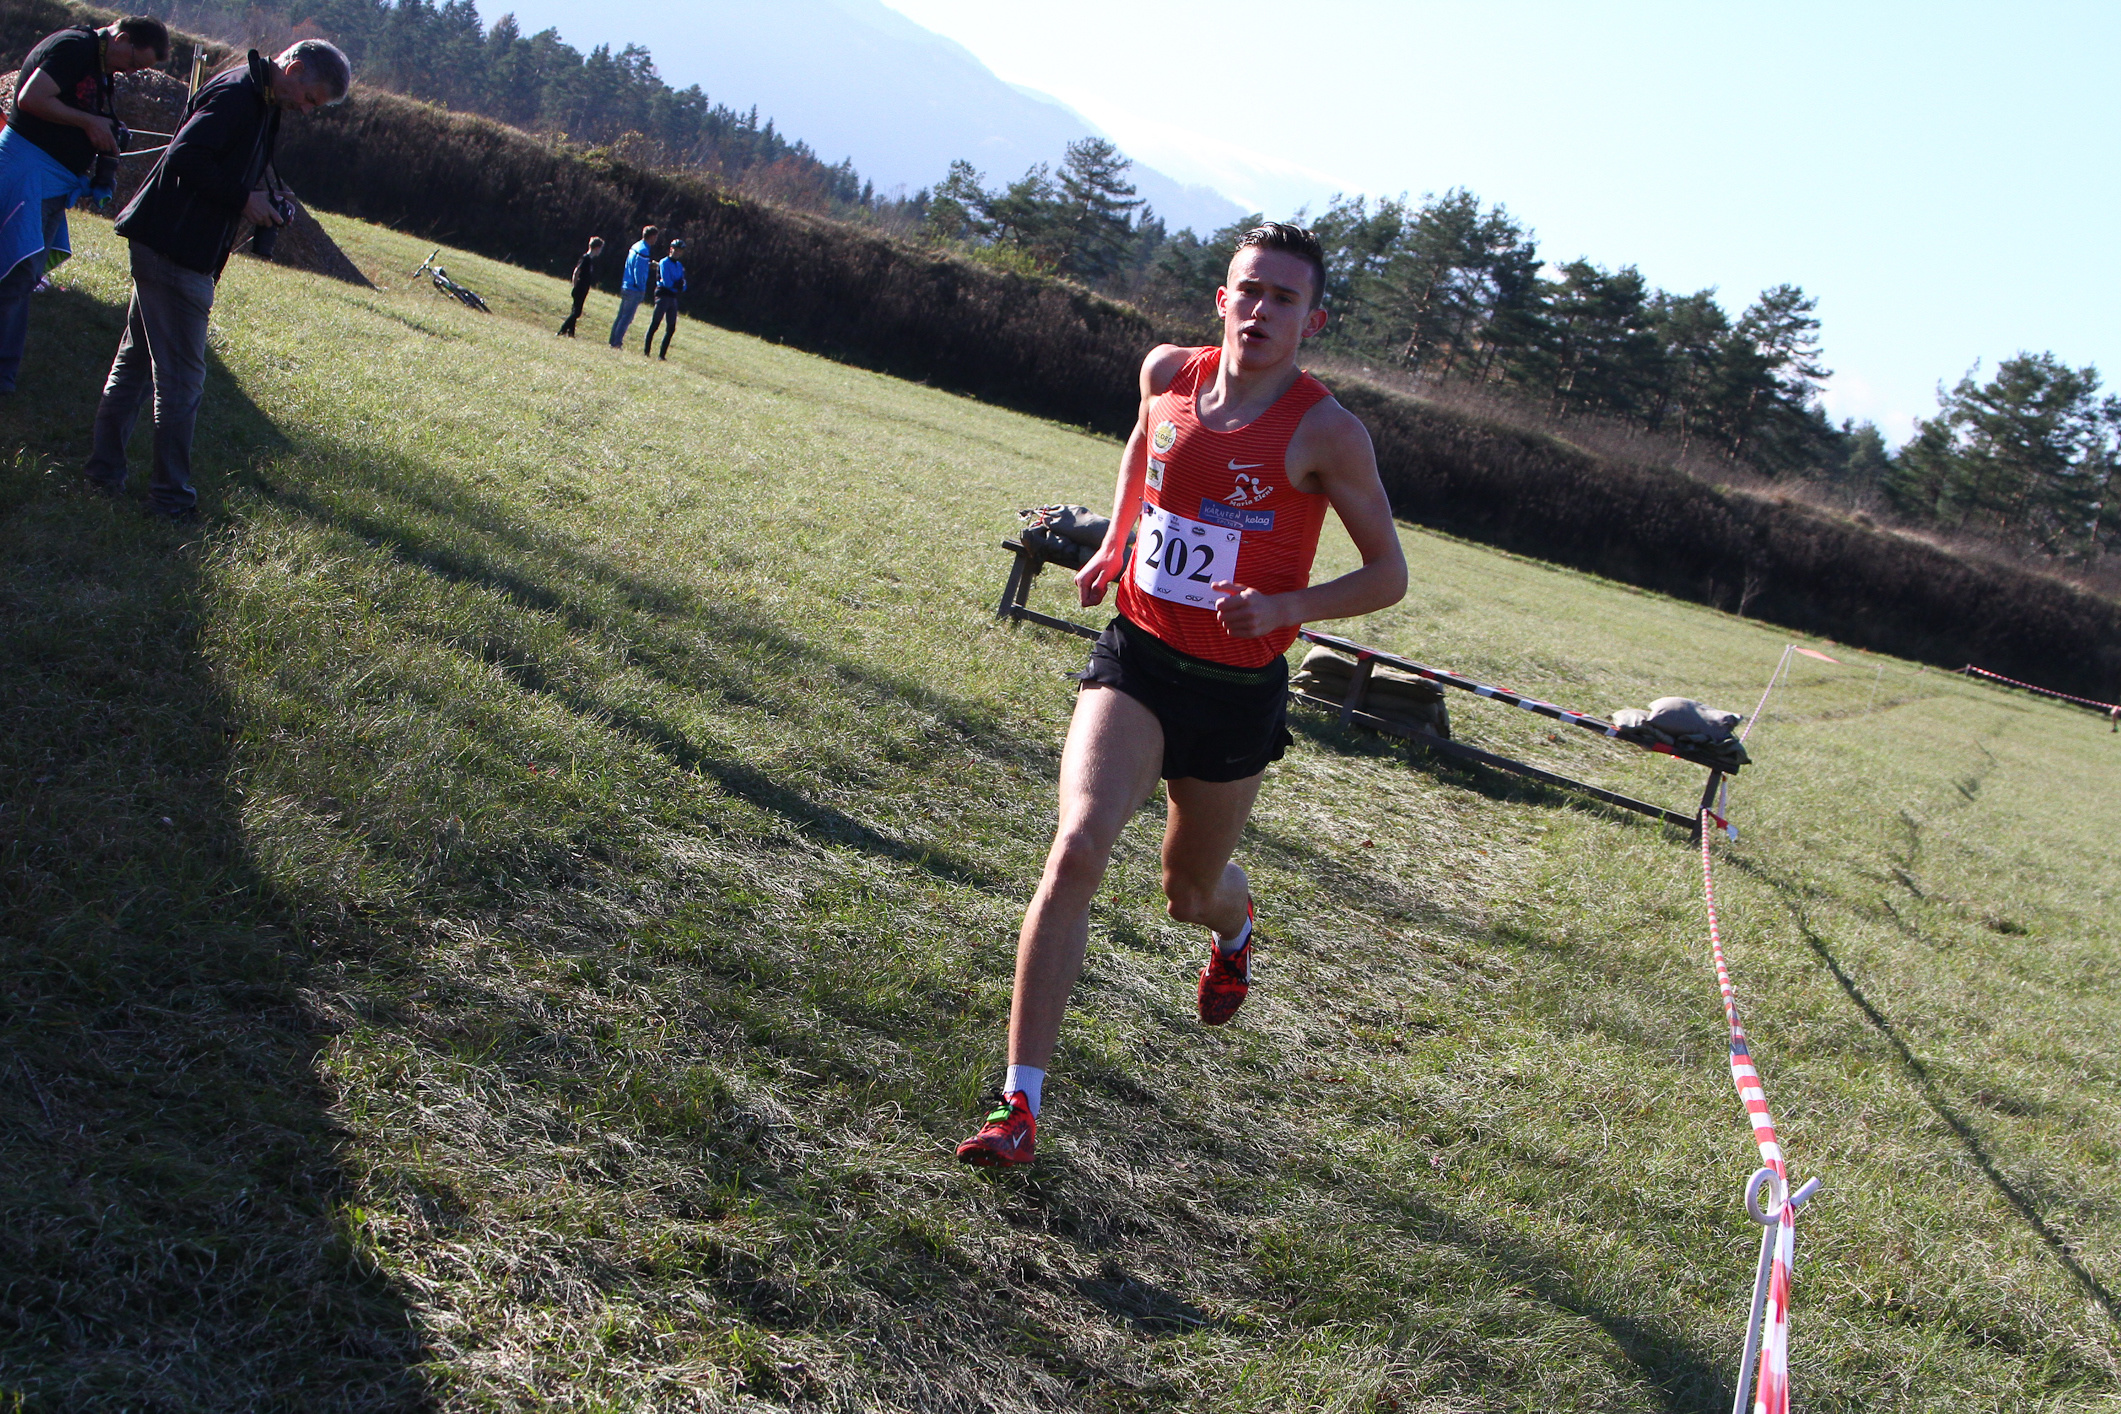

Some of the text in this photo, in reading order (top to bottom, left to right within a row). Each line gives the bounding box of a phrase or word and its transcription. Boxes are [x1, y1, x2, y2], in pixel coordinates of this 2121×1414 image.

[1229, 485, 1274, 507] Maria Elena
[1245, 514, 1270, 526] kelag
[1145, 529, 1214, 584] 202
